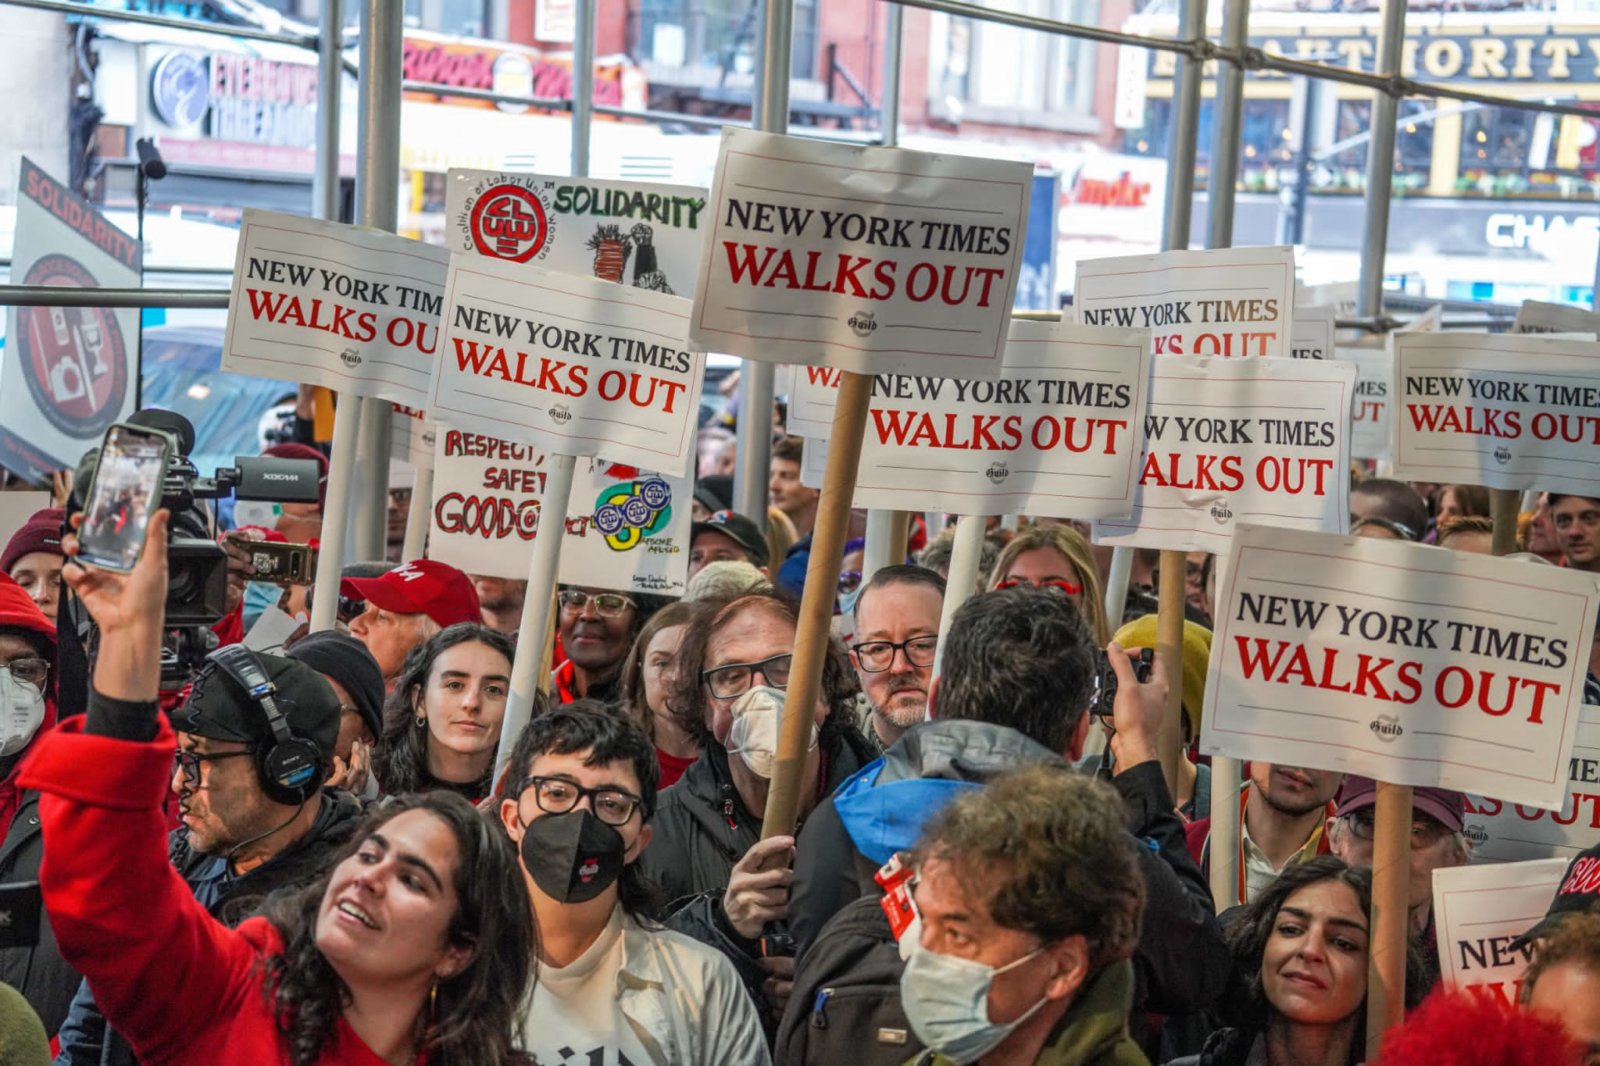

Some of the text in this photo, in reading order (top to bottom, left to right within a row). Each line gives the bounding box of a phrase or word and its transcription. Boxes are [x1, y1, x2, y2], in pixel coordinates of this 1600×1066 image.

[26, 169, 136, 266] SOLIDARITY
[552, 185, 707, 230] SOLIDARITY
[725, 198, 1011, 256] NEW YORK TIMES
[247, 257, 316, 288] NEW
[319, 269, 391, 306] YORK
[722, 241, 1005, 308] WALKS OUT
[246, 288, 378, 343] WALKS
[847, 317, 878, 332] Guild
[1084, 299, 1280, 328] NEW YORK TIMES
[453, 305, 691, 374] NEW YORK TIMES
[452, 337, 686, 414] WALKS OUT
[870, 374, 945, 401] NEW
[953, 379, 1032, 405] YORK
[1037, 379, 1131, 409] TIMES
[1406, 376, 1464, 398] NEW
[1467, 378, 1531, 404] YORK
[548, 407, 572, 421] Guild
[869, 408, 1022, 452] WALKS
[1031, 415, 1128, 455] OUT
[1174, 416, 1254, 445] YORK
[1259, 418, 1335, 448] TIMES
[1406, 404, 1600, 446] WALKS OUT
[985, 467, 1010, 480] Guild
[1139, 451, 1334, 496] ALKS OUT
[1210, 506, 1233, 519] Guild
[1236, 592, 1569, 669] NEW YORK TIMES
[1234, 635, 1562, 725] WALKS OUT
[1369, 720, 1404, 737] Guild
